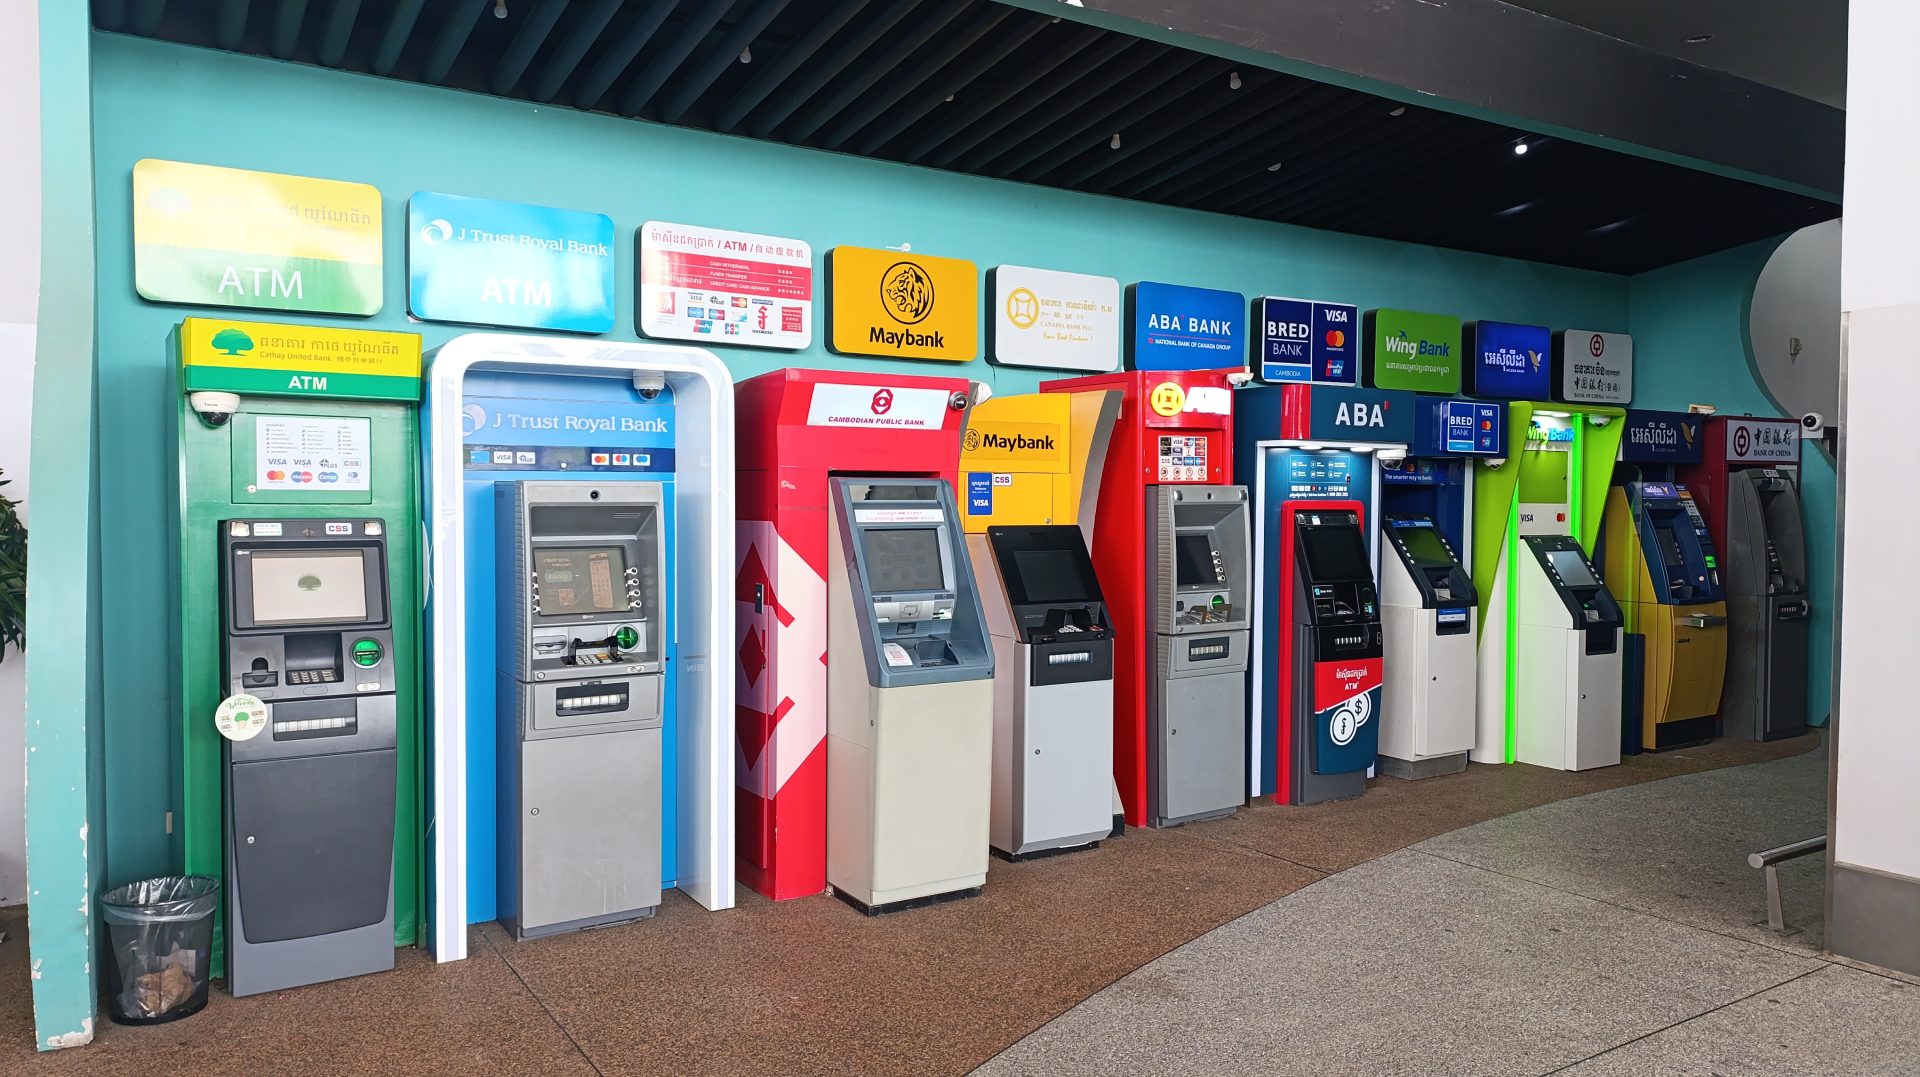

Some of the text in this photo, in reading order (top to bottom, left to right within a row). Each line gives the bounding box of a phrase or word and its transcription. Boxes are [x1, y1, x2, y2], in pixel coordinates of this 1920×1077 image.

[457, 229, 608, 256] J Trust Royal Bank
[723, 240, 747, 252] ATM
[218, 265, 303, 299] ATM
[480, 276, 552, 307] ATM
[1324, 309, 1347, 322] VISA
[1040, 321, 1065, 329] CANADIA
[1066, 322, 1081, 330] BANK
[1148, 314, 1231, 336] ABA BANK
[1267, 321, 1309, 338] BRED
[869, 327, 944, 348] Maybank
[1216, 343, 1231, 351] GROUP
[1273, 343, 1302, 356] BANK
[1385, 335, 1450, 360] Wing Bank
[260, 351, 286, 360] Cathay
[287, 352, 312, 361] United
[313, 354, 331, 362] Bank
[288, 376, 327, 390] ATM
[828, 416, 873, 424] CAMBODIAN
[1335, 402, 1384, 427] ABA
[1450, 416, 1473, 426] BRED
[492, 413, 668, 433] J Trust Royal Bank
[1548, 427, 1575, 442] Bank
[983, 433, 1054, 452] Maybank
[1753, 449, 1791, 457] BANK OF CHINA
[973, 499, 989, 507] VISA
[1520, 514, 1533, 522] VISA
[1344, 683, 1358, 691] ATM
